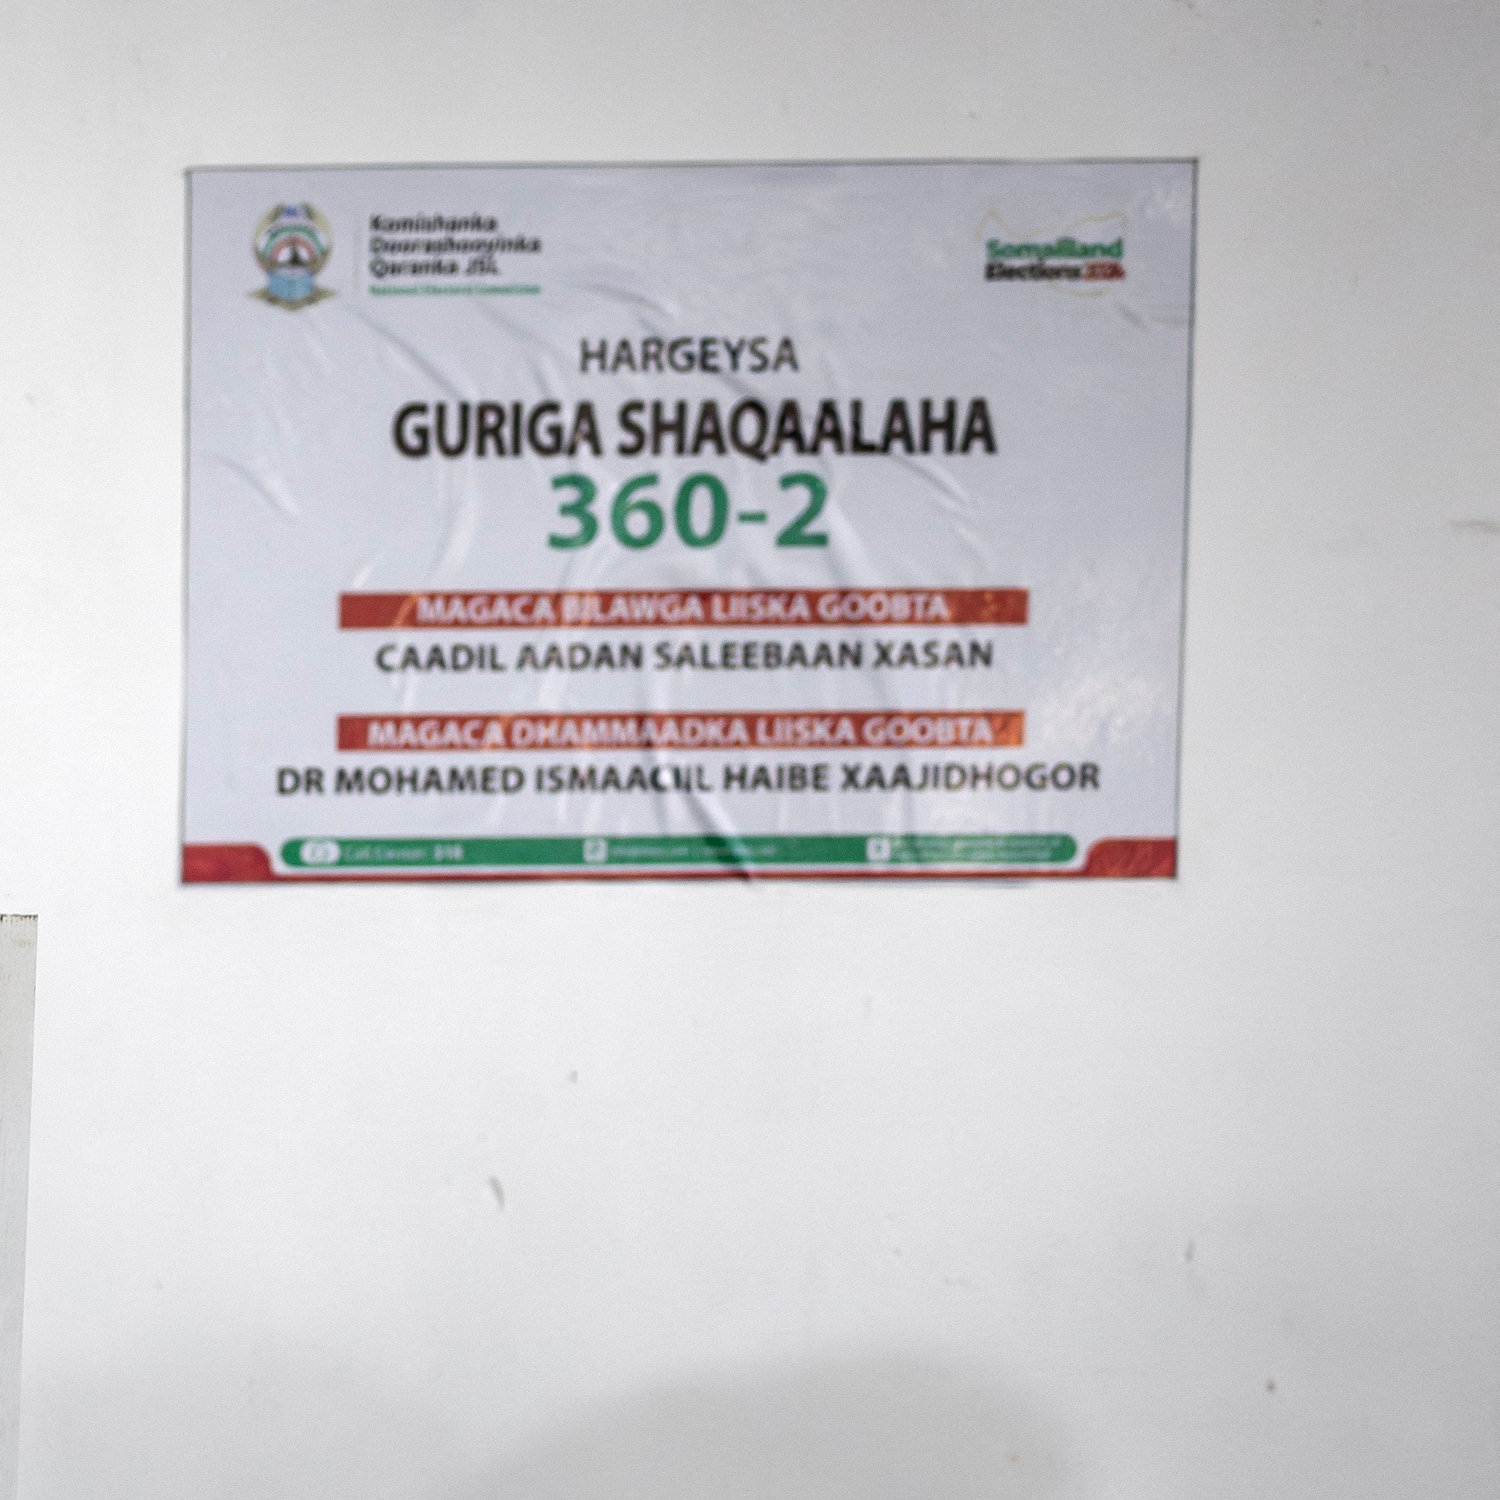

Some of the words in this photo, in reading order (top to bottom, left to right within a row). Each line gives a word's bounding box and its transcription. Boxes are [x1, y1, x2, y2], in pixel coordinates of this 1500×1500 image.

[581, 337, 798, 374] HARGEYSA
[393, 401, 602, 458] GURIGA
[619, 398, 996, 462] SHAQAALAHA
[548, 471, 829, 550] 360-2
[416, 595, 554, 624] MAGACA
[562, 594, 702, 623] BILAWGA
[817, 593, 950, 622] GOOBTA
[375, 644, 504, 673] CAADIL
[517, 643, 643, 670] AADAN
[655, 642, 863, 670] SALEEBAAN
[874, 641, 993, 668] XASAN
[367, 719, 505, 748] MAGACA
[511, 718, 749, 747] DHAMMAADKA
[756, 717, 856, 746] LIISKA
[863, 716, 994, 745] GOOBTA
[277, 767, 324, 796] DR
[335, 766, 525, 794] MOHAMED
[723, 764, 827, 791] HAIBE
[841, 762, 1100, 791] XAAJIDHOGOR
